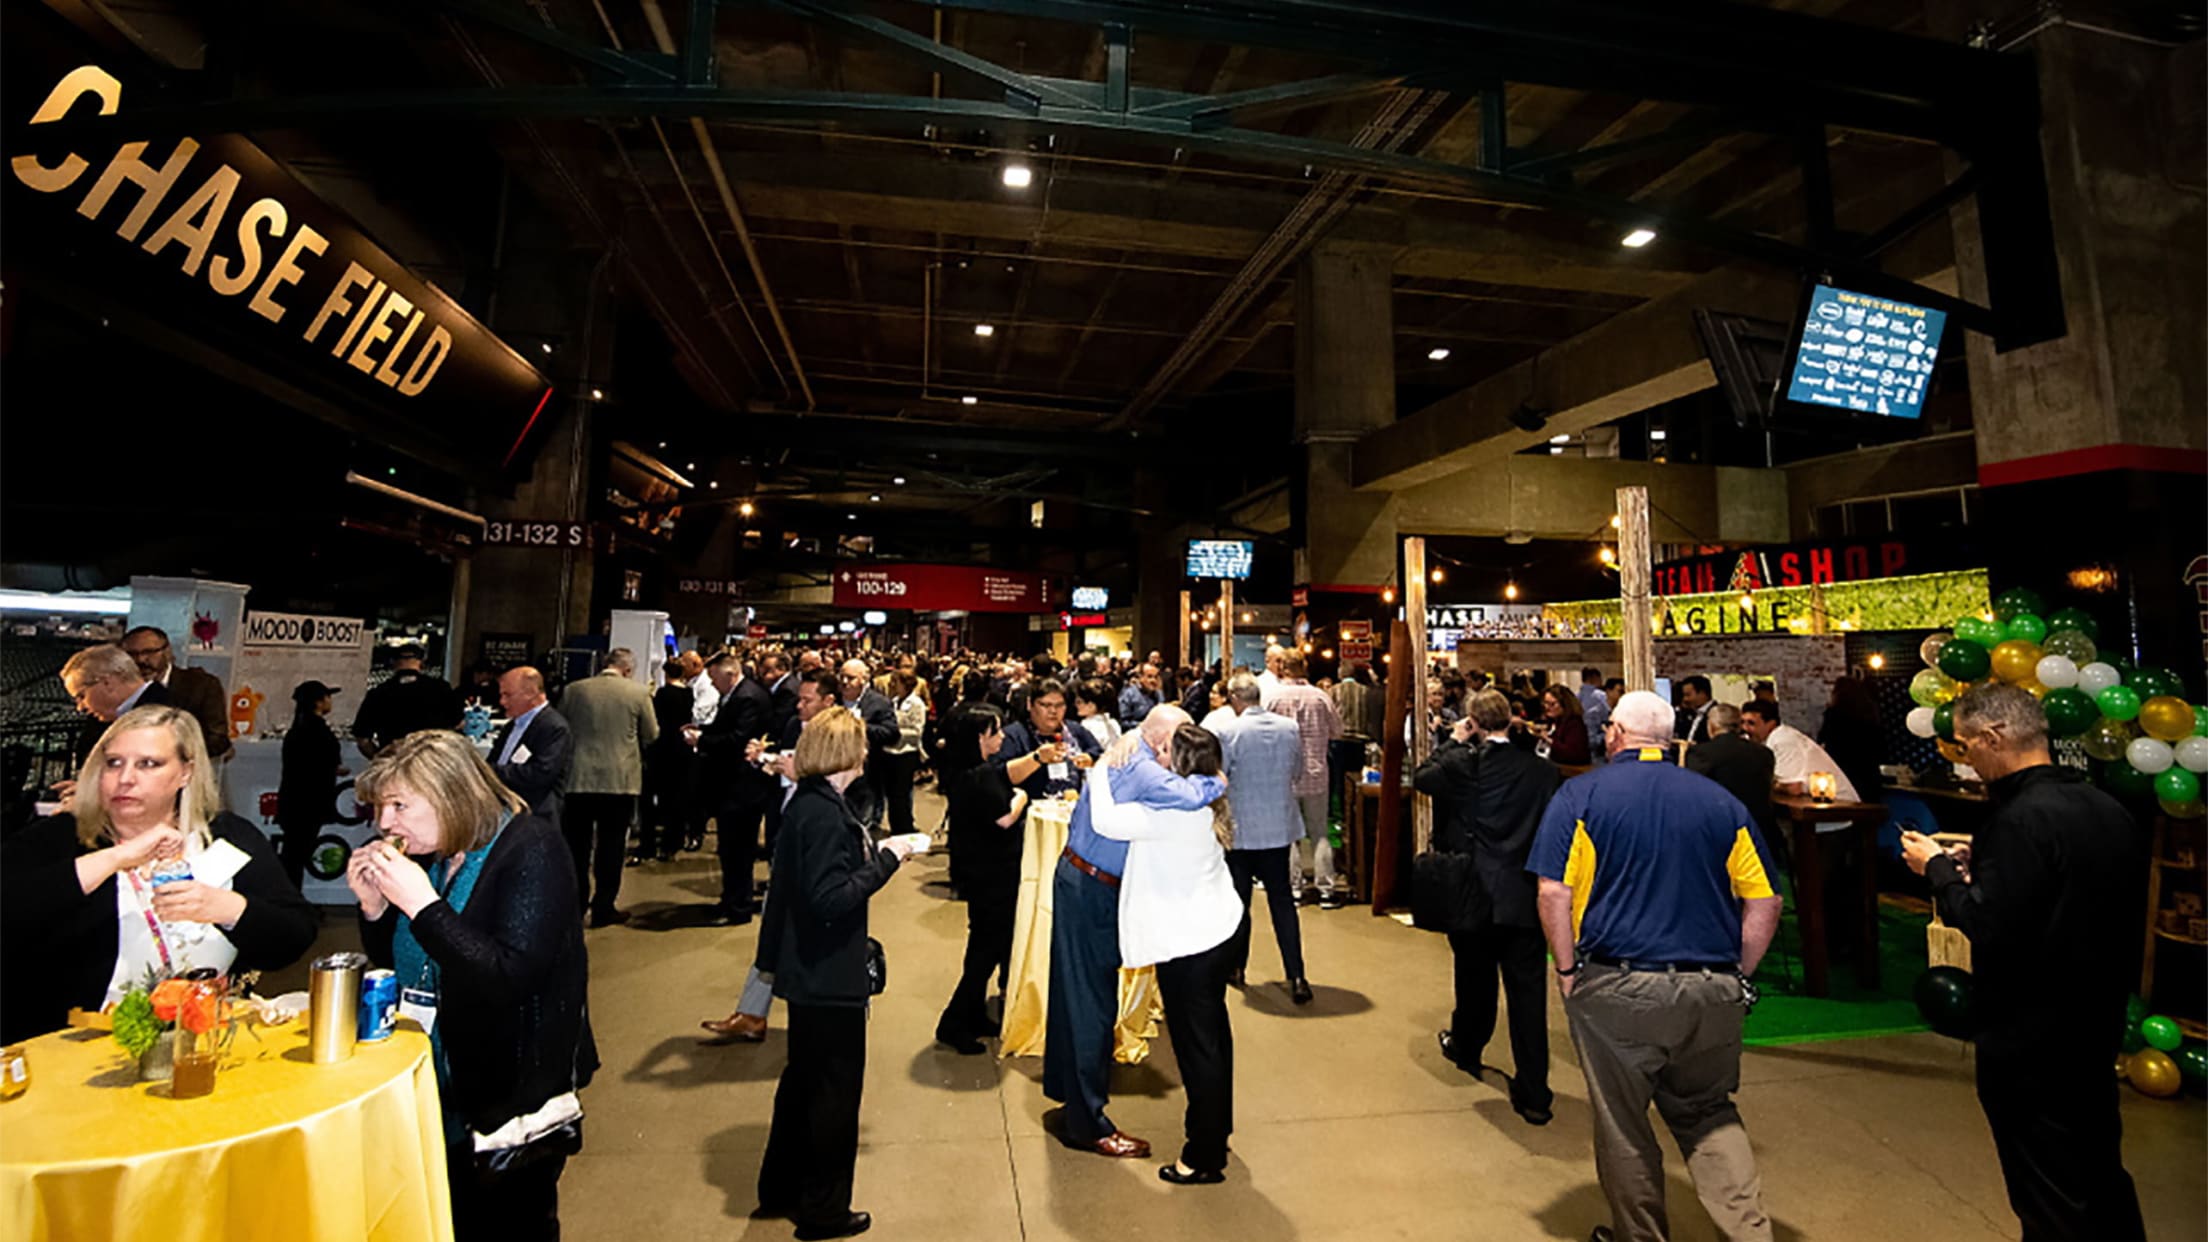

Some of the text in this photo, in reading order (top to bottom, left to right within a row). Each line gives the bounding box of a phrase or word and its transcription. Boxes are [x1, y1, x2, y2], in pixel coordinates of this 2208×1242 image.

[11, 64, 453, 397] CHASE FIELD
[1780, 543, 1906, 588] SHOP
[856, 580, 907, 596] 100-129
[247, 618, 361, 643] MOOD BOOST
[1426, 608, 1482, 627] HASE
[1661, 602, 1790, 636] AGINE
